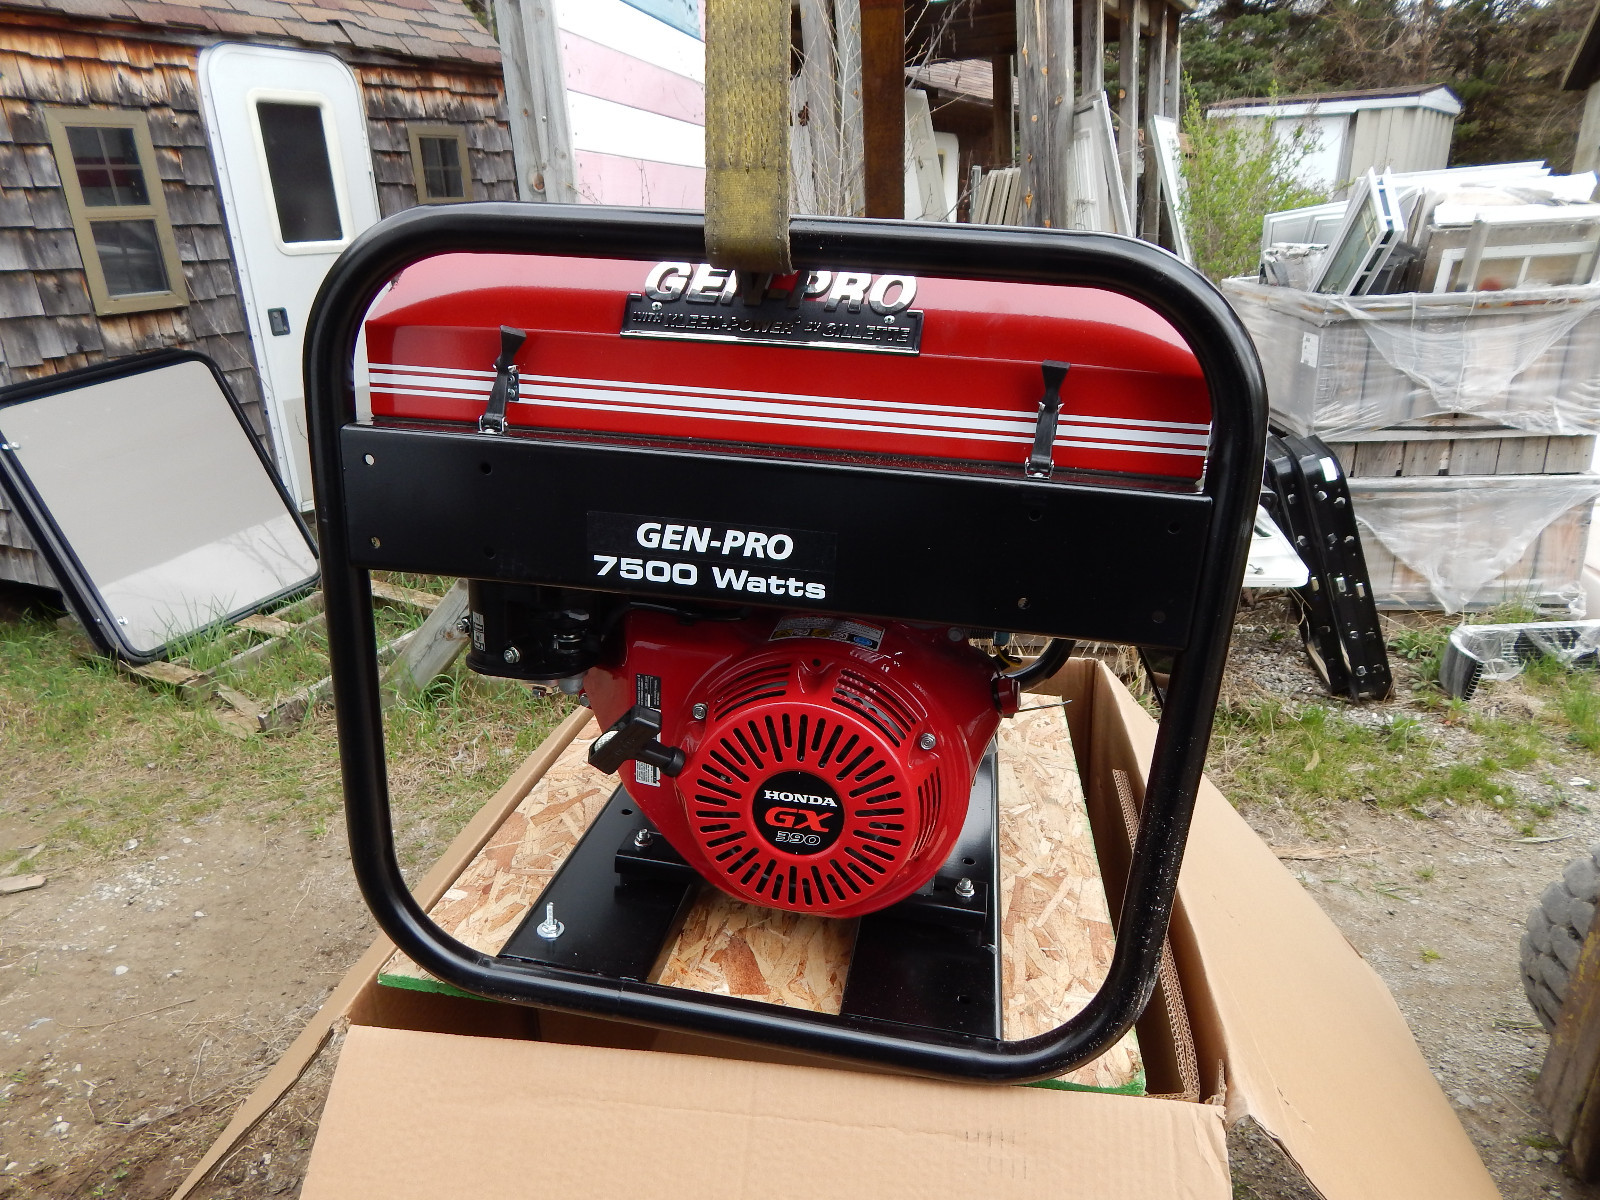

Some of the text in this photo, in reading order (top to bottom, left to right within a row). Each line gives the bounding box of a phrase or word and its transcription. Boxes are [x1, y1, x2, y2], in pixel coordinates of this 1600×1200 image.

[645, 261, 917, 315] GEN-PRO
[632, 311, 665, 324] WITH
[821, 321, 912, 343] GILLETTE
[636, 522, 794, 560] GEN-PRO
[593, 554, 826, 600] 7500 Watts
[763, 789, 838, 808] HONDA
[764, 806, 834, 833] GX
[775, 830, 821, 846] 390
